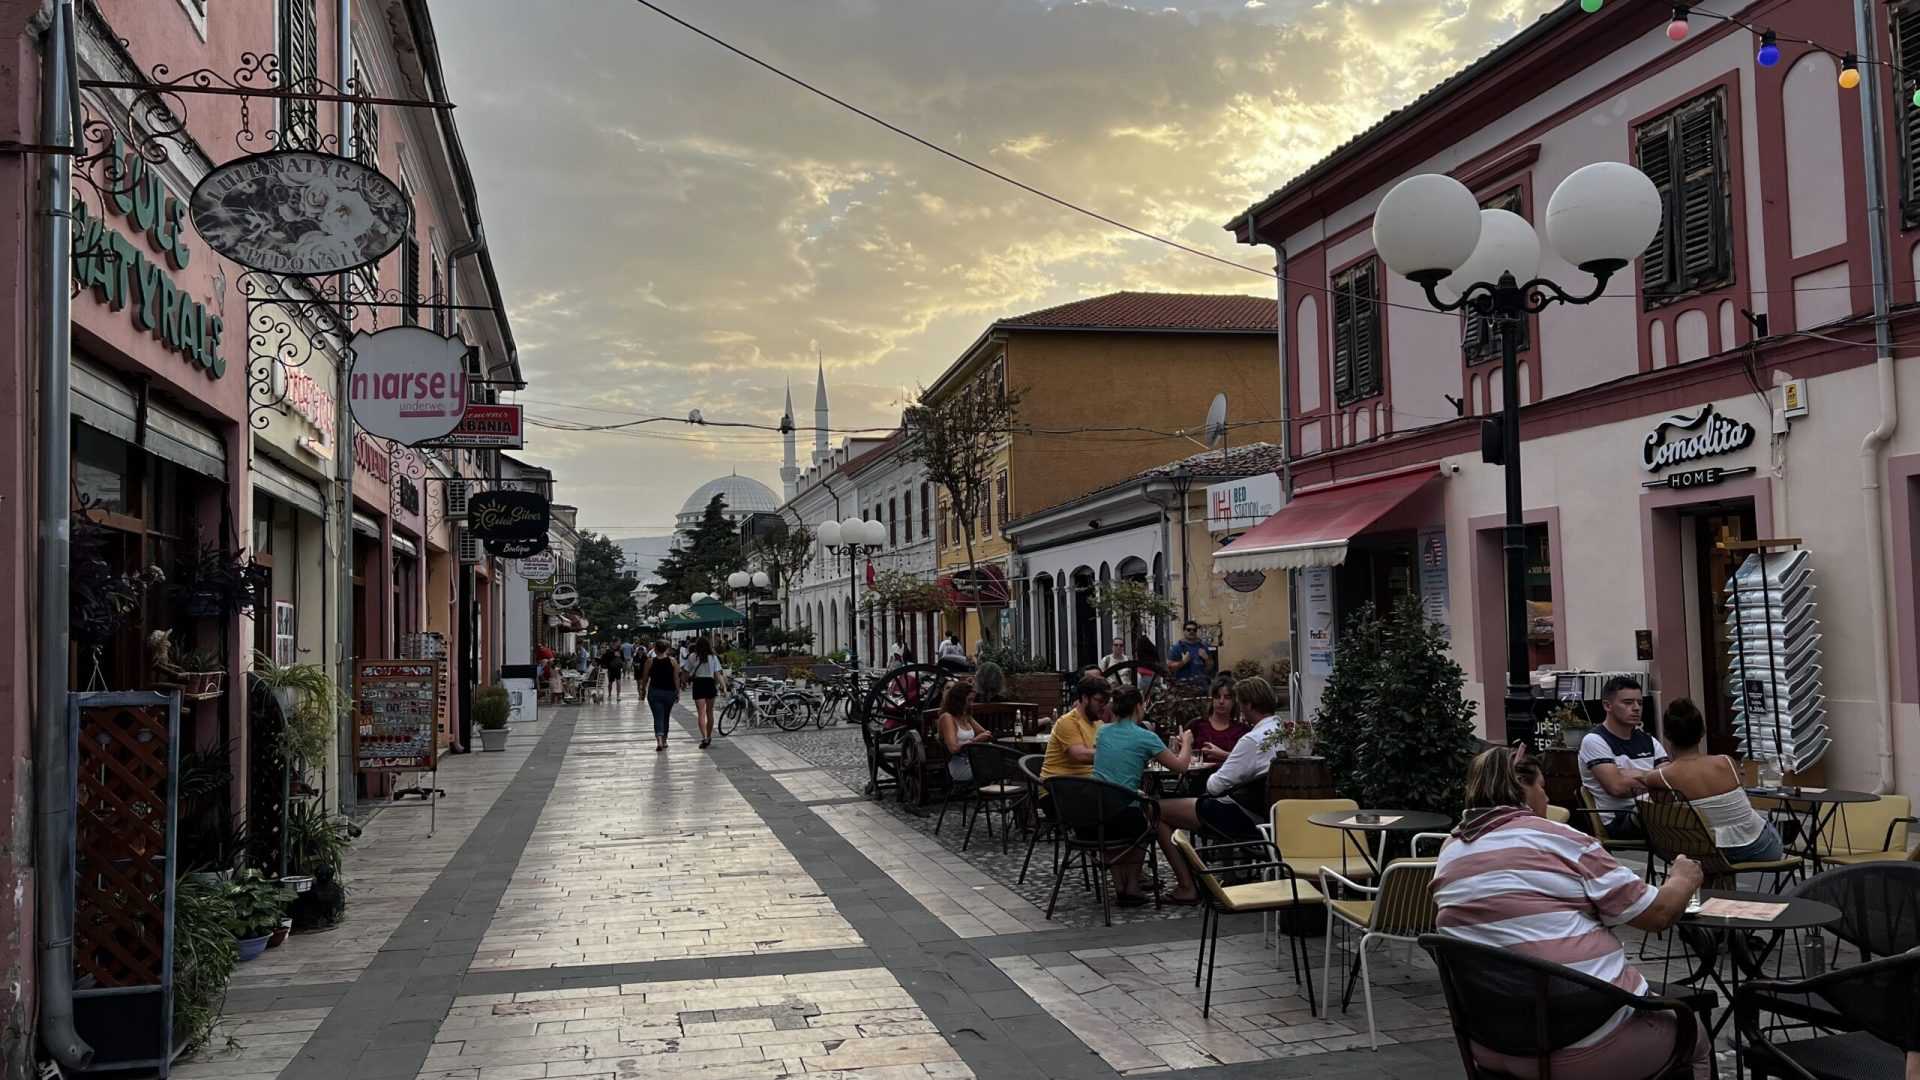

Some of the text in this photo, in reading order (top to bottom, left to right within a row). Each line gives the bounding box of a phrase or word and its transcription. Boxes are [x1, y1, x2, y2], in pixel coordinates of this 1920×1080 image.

[206, 163, 262, 202] LULE
[107, 132, 190, 269] LULE
[352, 372, 465, 417] marsey
[457, 420, 512, 433] LBANIA
[1641, 414, 1749, 471] Comodita
[1671, 469, 1715, 487] HOME
[1234, 486, 1246, 503] BED
[511, 506, 541, 522] Silver
[1234, 502, 1259, 520] STATION
[502, 543, 530, 555] Boutique
[1310, 629, 1327, 640] FedEx
